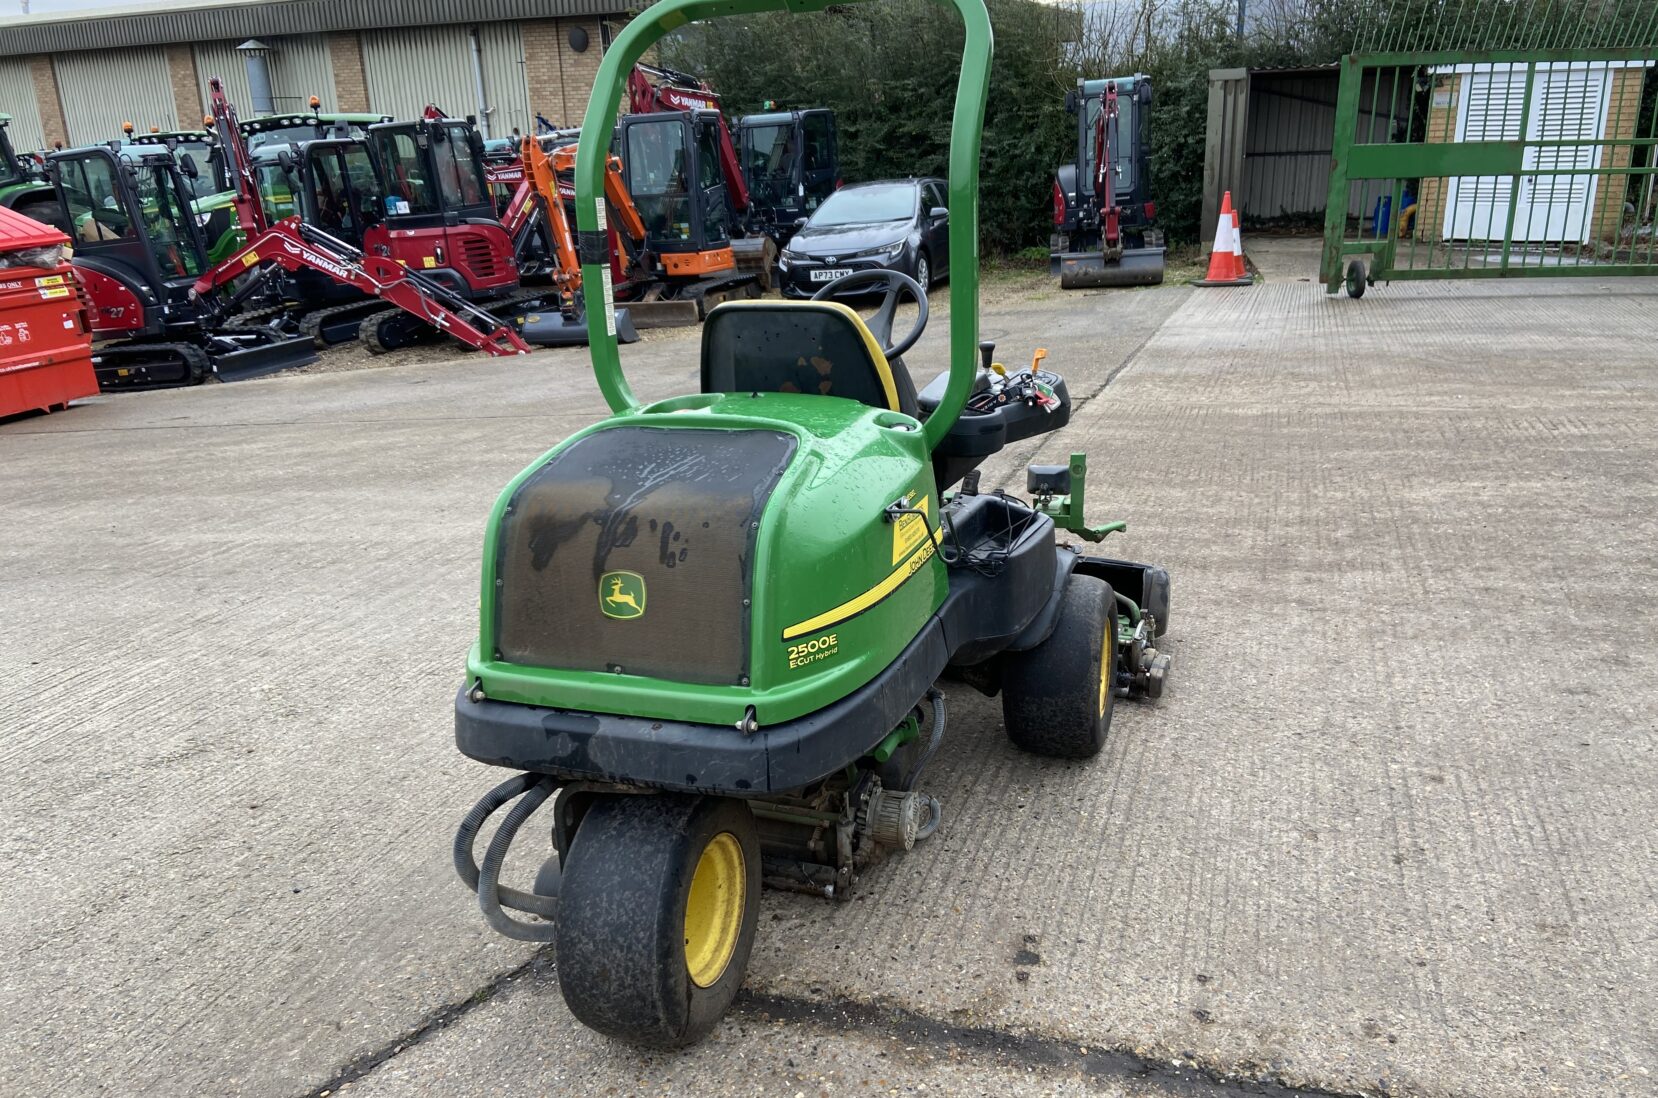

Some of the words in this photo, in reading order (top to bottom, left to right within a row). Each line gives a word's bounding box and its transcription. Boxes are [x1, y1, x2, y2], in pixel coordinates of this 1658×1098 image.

[681, 96, 706, 109] YANMAR
[497, 171, 522, 180] YANMAR
[302, 250, 348, 278] YANMAR
[813, 271, 834, 280] AP73
[110, 306, 125, 318] 27
[909, 555, 923, 575] JOHN
[788, 634, 838, 660] 2500E
[815, 646, 838, 660] Hybrid
